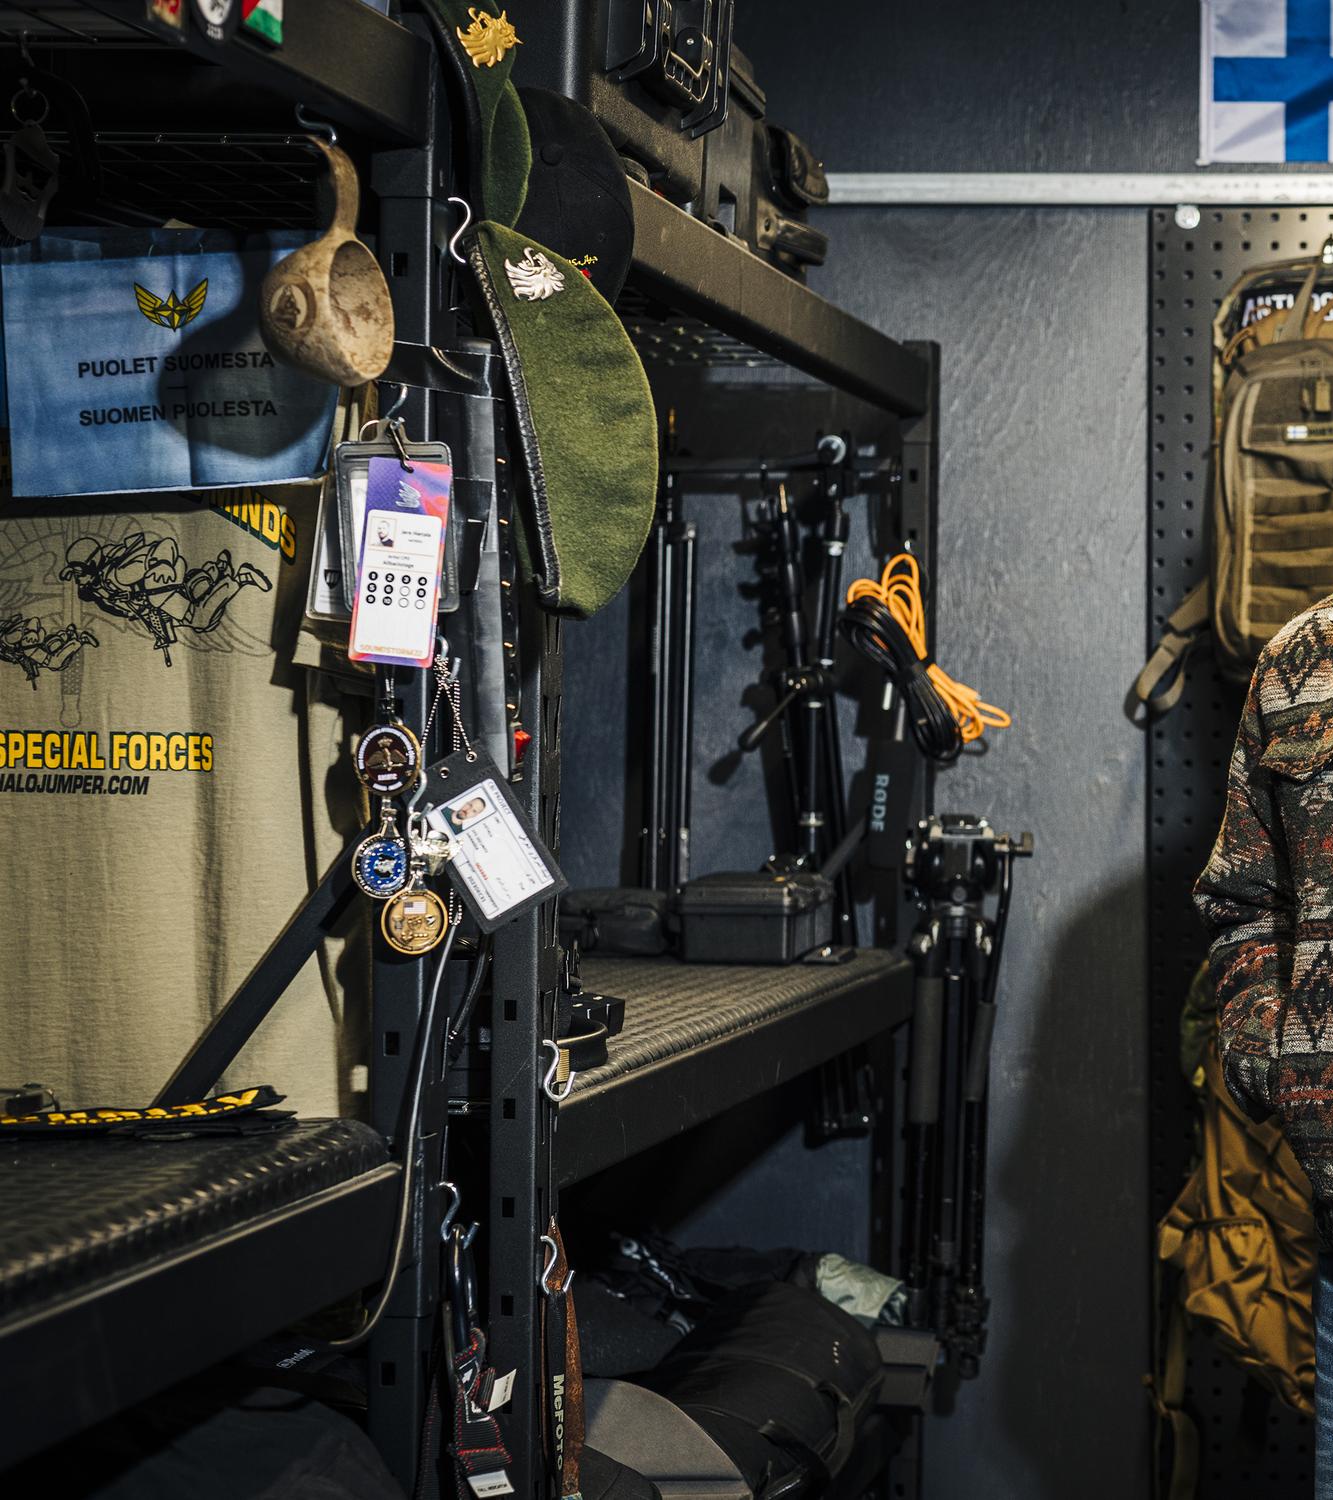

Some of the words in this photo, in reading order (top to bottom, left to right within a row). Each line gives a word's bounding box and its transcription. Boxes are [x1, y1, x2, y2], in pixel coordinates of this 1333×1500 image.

[78, 357, 158, 378] PUOLET
[164, 352, 275, 372] SUOMESTA
[79, 405, 167, 427] SUOMEN
[173, 400, 278, 420] PUOLESTA
[109, 731, 214, 772] FORCES
[0, 773, 150, 796] ALOJUMPER.COM
